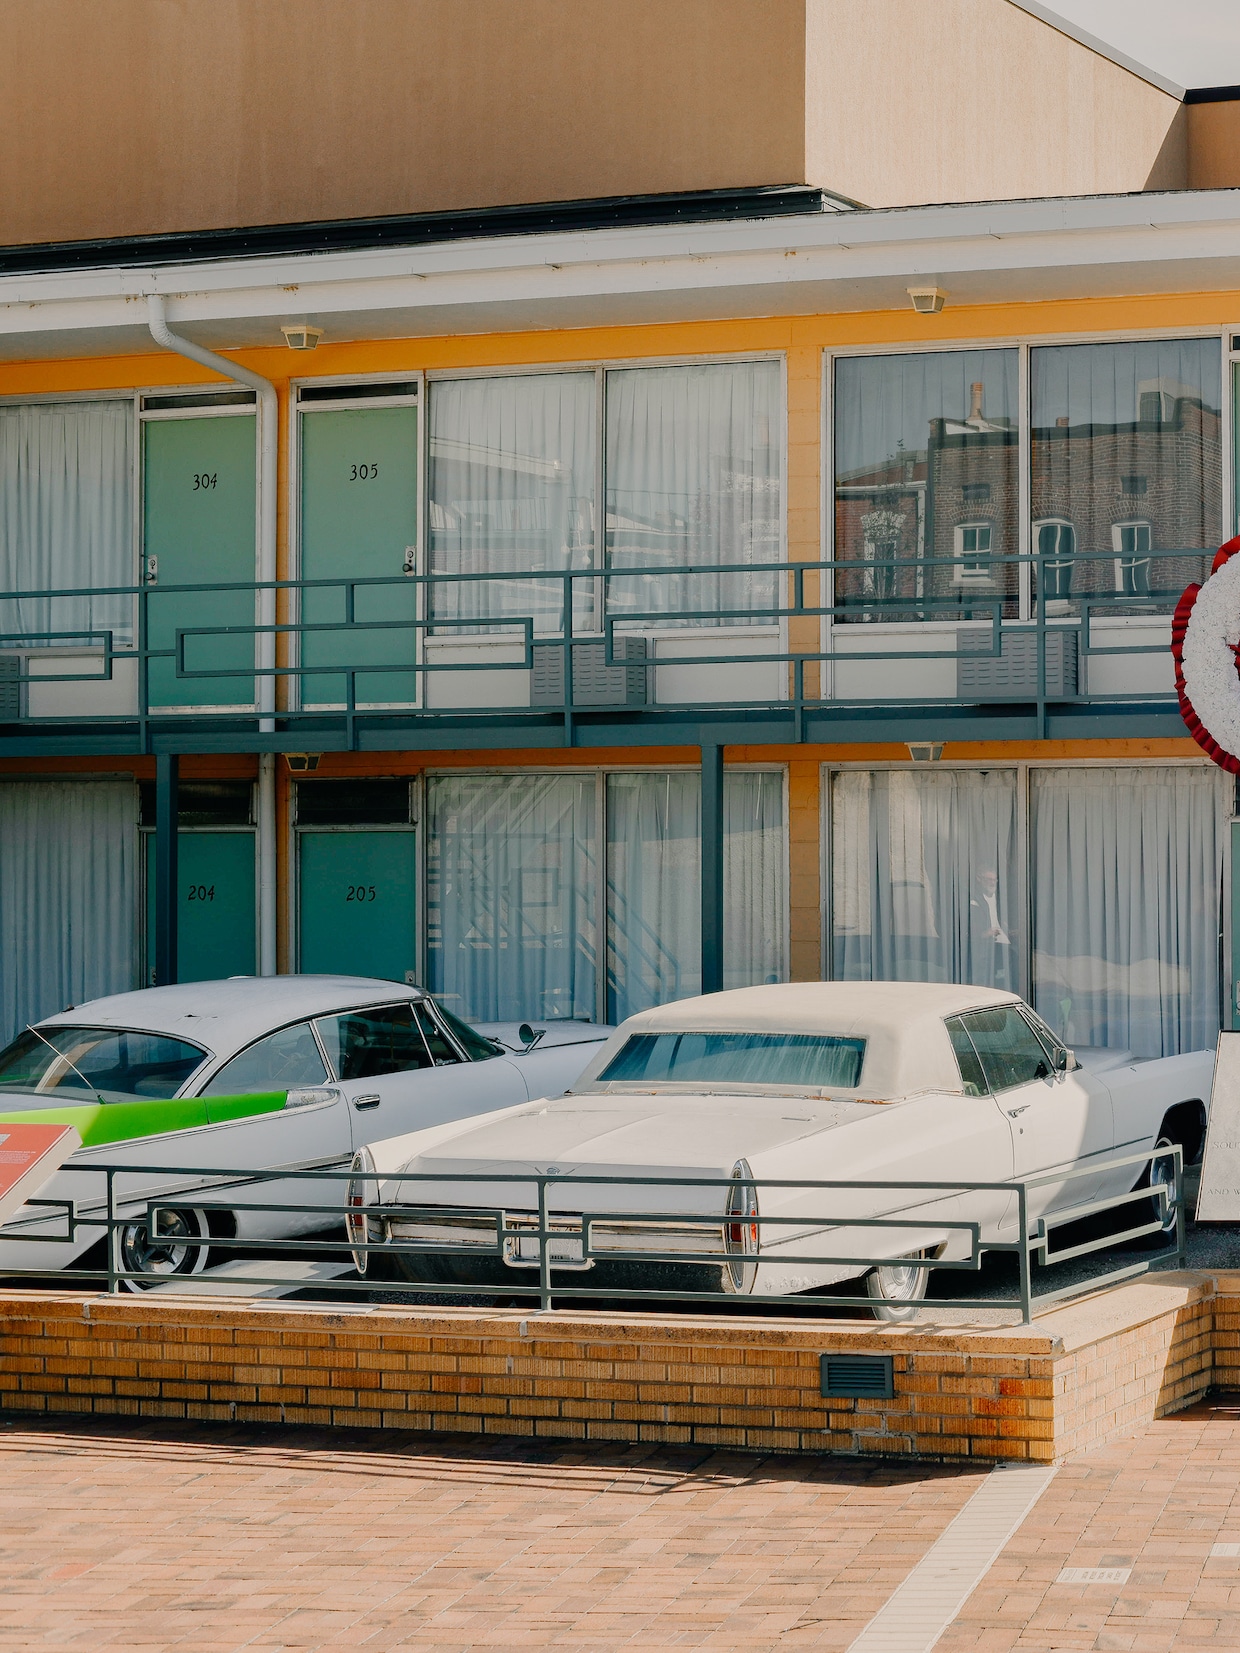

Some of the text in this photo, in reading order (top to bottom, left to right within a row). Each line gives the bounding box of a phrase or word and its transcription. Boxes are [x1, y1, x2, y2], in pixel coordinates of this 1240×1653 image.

[349, 463, 378, 481] 305
[192, 472, 218, 491] 304
[187, 885, 215, 902] 204
[346, 885, 376, 902] 205
